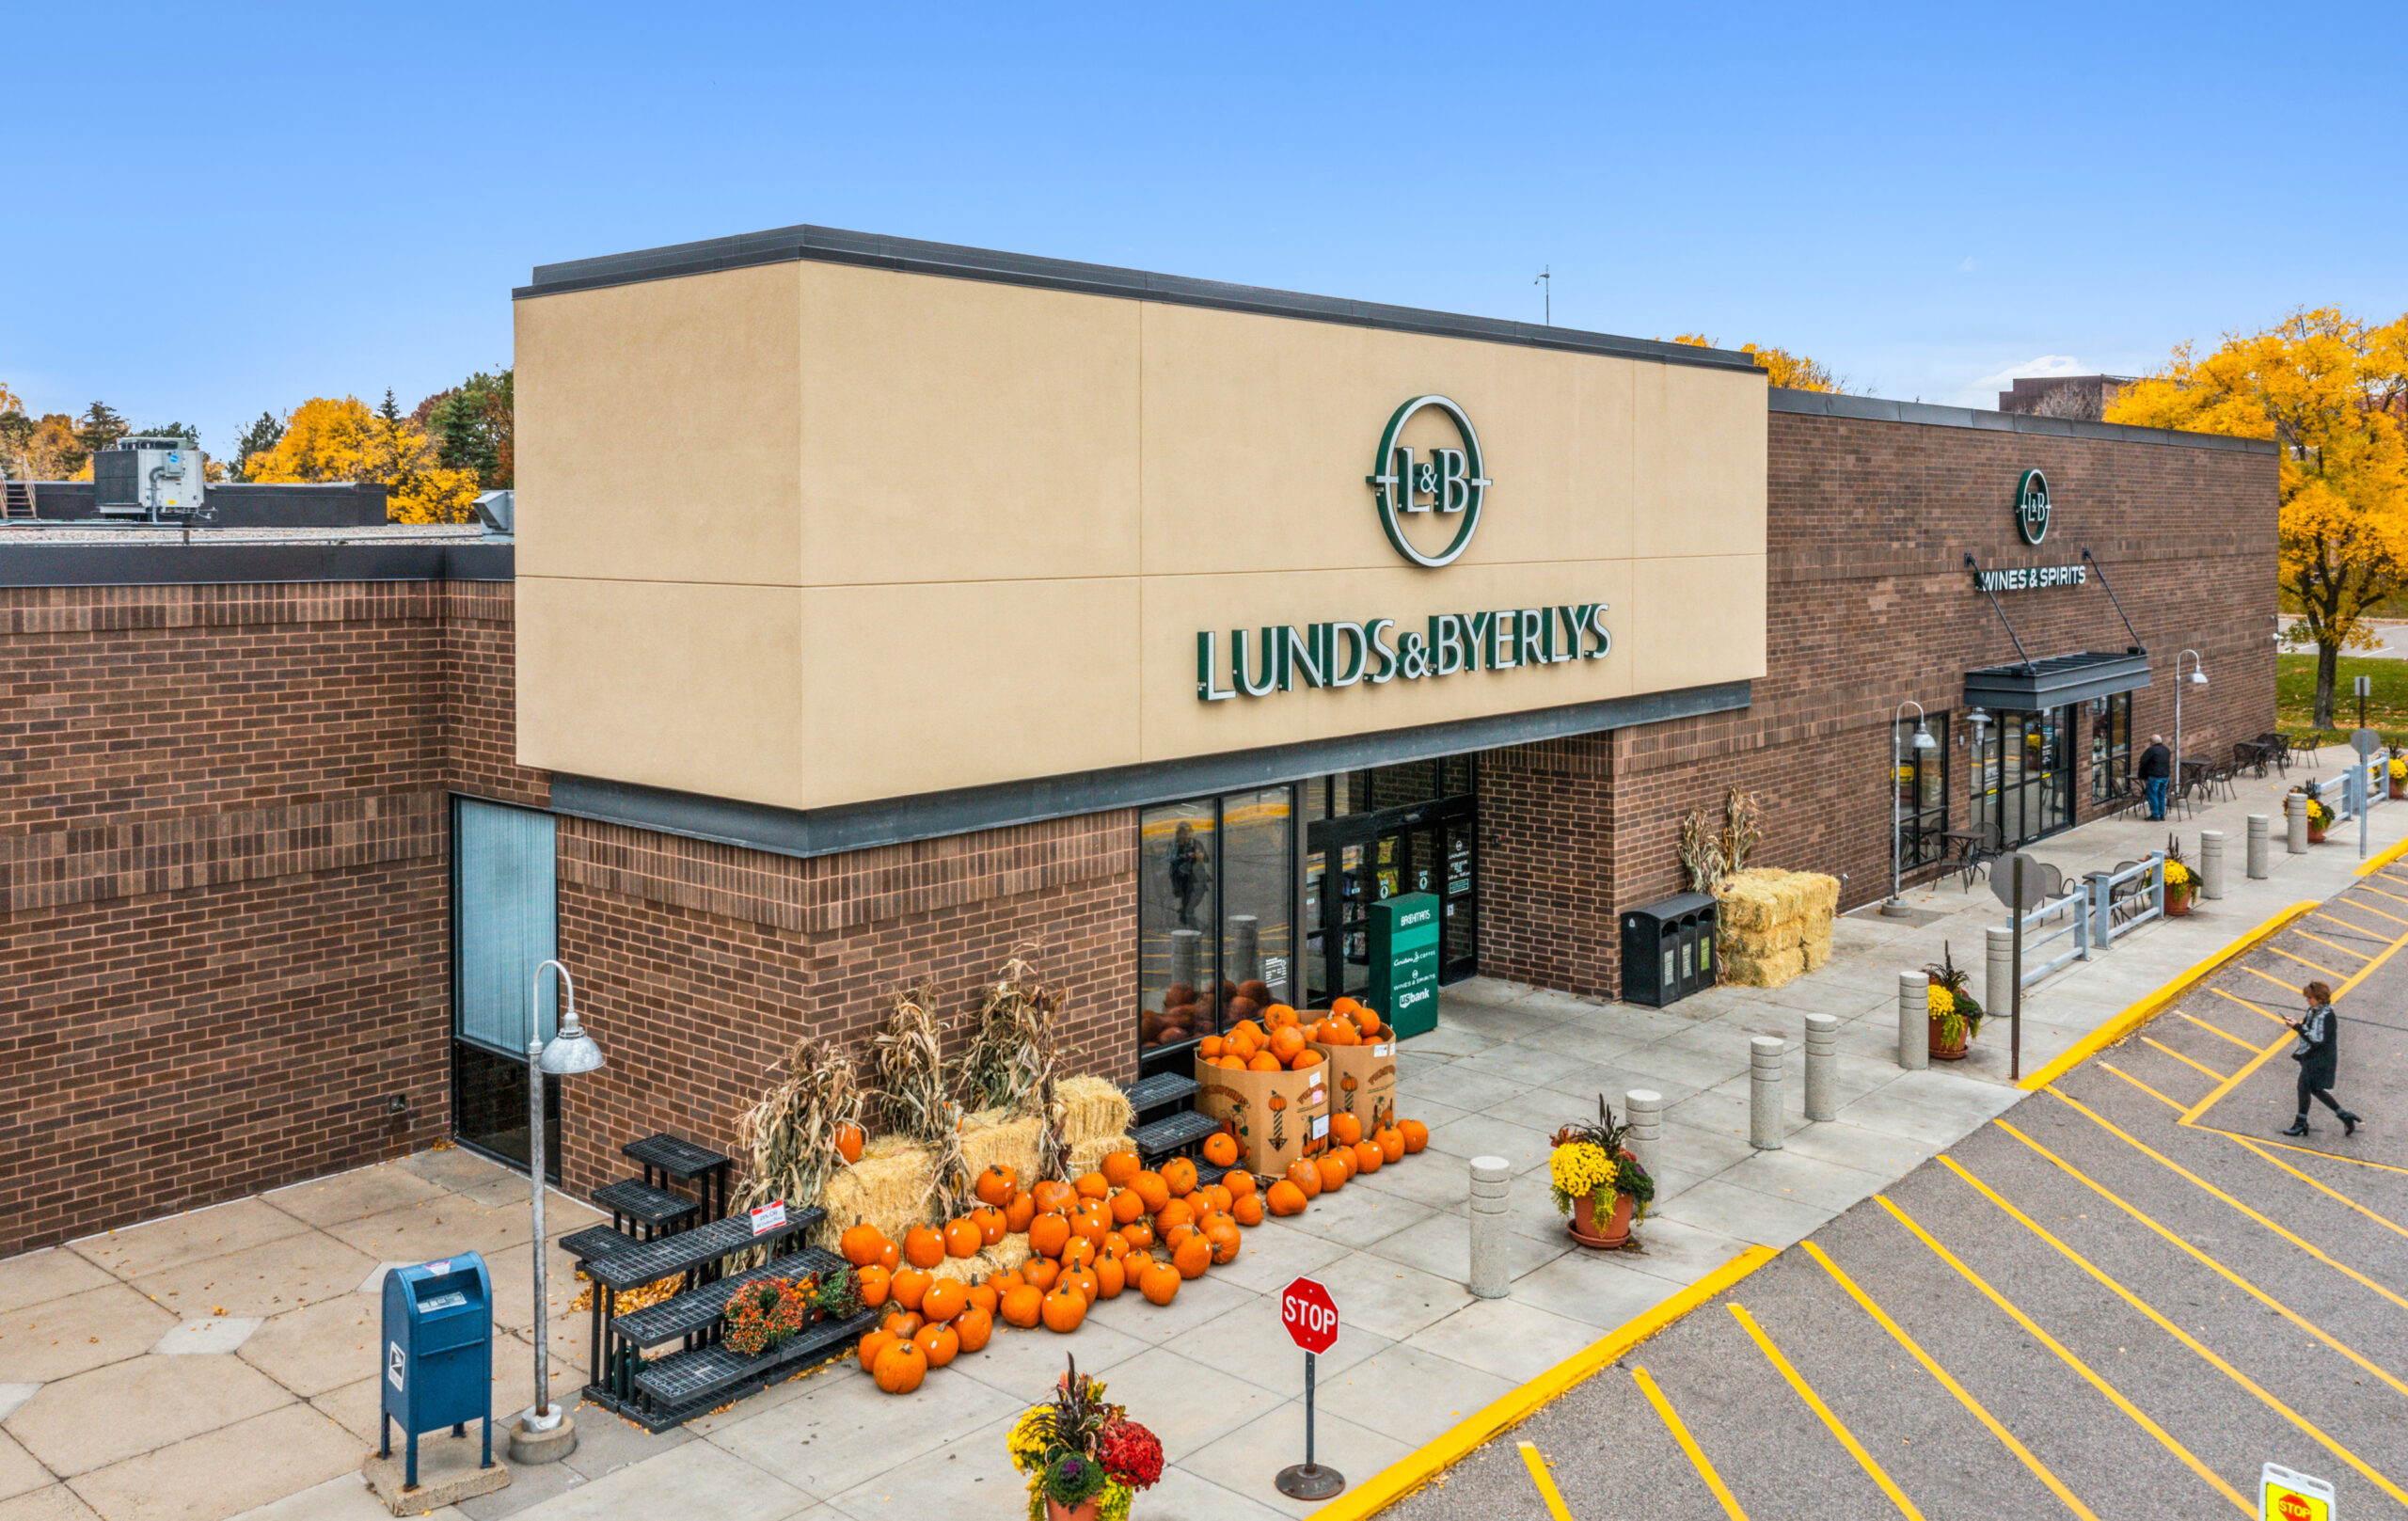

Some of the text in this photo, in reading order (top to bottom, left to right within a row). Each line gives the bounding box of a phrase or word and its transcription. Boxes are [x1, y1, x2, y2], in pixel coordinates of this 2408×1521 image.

[1396, 447, 1469, 513] L&B
[2026, 492, 2046, 522] L&B
[1980, 565, 2086, 592] WINES & SPIRITS
[1393, 980, 1411, 991] WINES
[1416, 974, 1436, 985] SPIRITS
[1284, 1295, 1337, 1335] STOP
[2279, 1500, 2311, 1518] STOP
